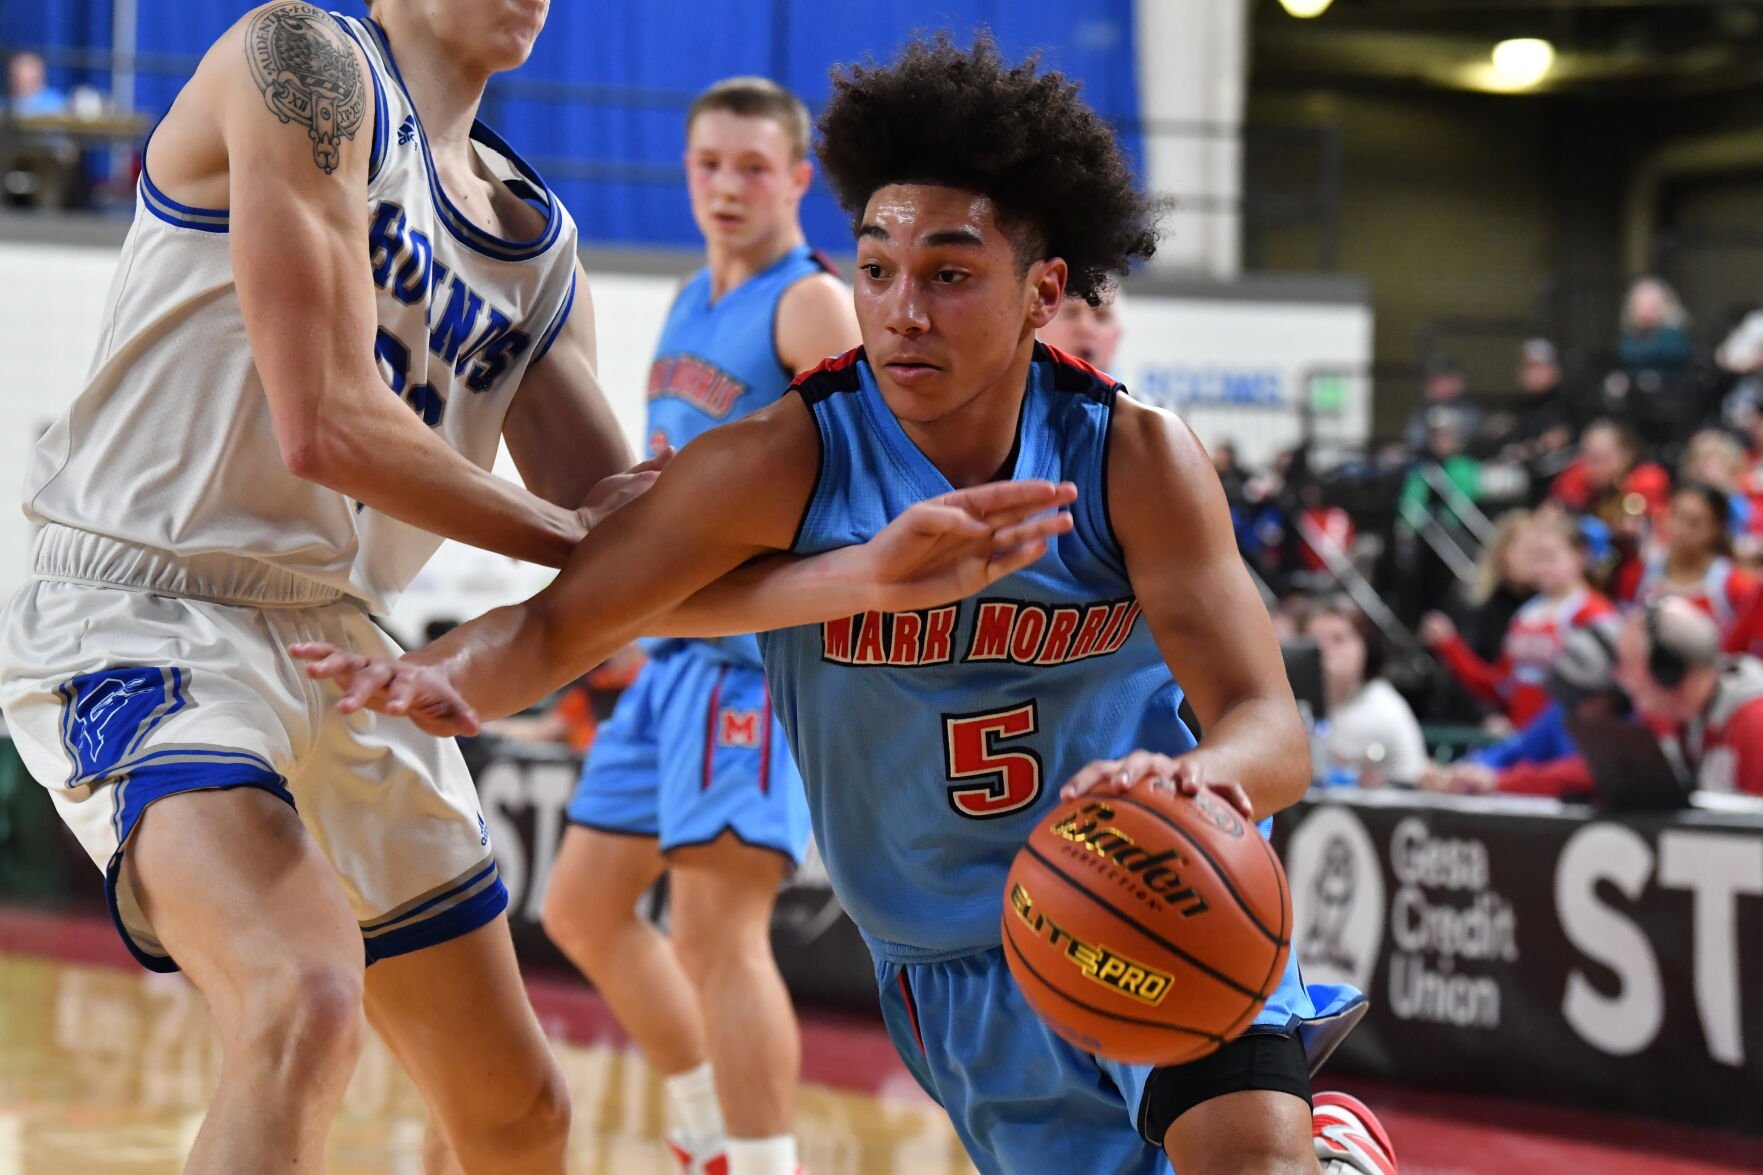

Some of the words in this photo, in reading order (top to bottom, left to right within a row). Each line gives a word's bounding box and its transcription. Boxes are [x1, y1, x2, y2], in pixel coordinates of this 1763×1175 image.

[822, 604, 959, 667] MARK
[719, 710, 760, 748] M
[942, 699, 1043, 820] 5
[1050, 803, 1208, 917] Baden
[1389, 818, 1490, 890] Gesa
[1391, 886, 1518, 962] Credit
[1388, 953, 1500, 1029] Union
